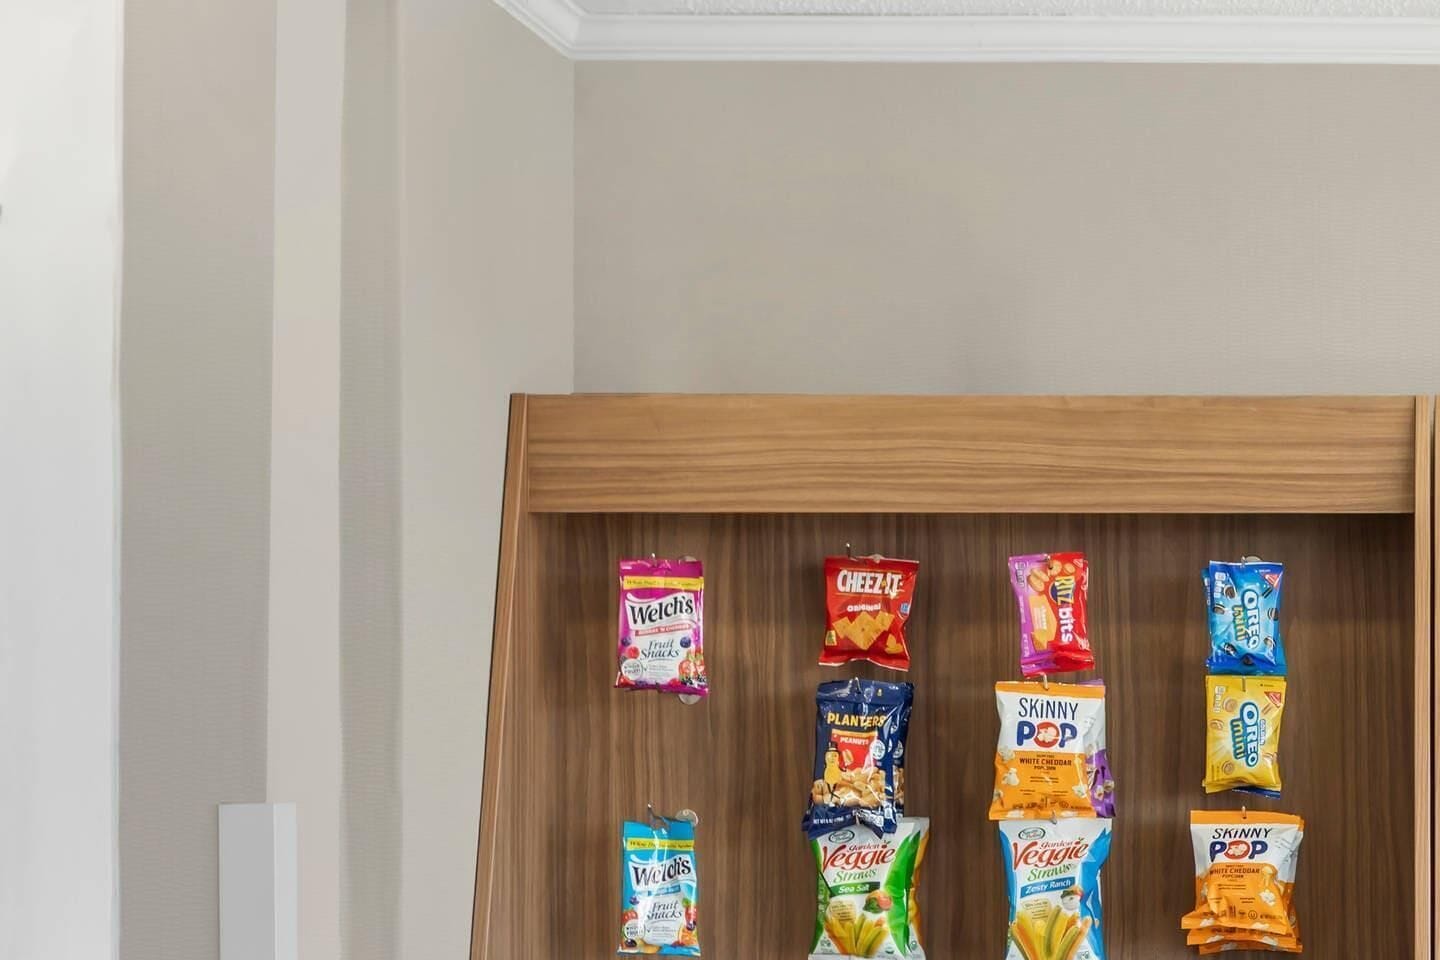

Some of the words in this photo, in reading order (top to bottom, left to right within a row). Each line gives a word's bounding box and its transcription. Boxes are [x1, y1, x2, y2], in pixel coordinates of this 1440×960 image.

[629, 595, 694, 625] Welch's
[1243, 589, 1260, 649] OREO
[641, 648, 680, 659] Snacks
[648, 639, 674, 651] Fruit
[827, 711, 888, 728] PLANTERS
[1016, 720, 1078, 748] POP
[1231, 719, 1245, 759] mini
[1242, 703, 1258, 767] OREO
[1019, 757, 1040, 765] WHITE
[1041, 758, 1073, 766] CHEDDAR
[822, 844, 896, 873] Veggie
[1012, 841, 1089, 870] Veggie
[1209, 840, 1269, 862] POP
[632, 857, 692, 886] Welch's
[833, 868, 877, 884] Straws
[1027, 863, 1072, 882] Straws
[838, 886, 855, 894] Sea
[856, 884, 870, 893] Salt
[1025, 884, 1049, 894] Zesty
[1050, 880, 1072, 890] Ranch
[646, 909, 682, 921] Snacks
[651, 900, 679, 912] Fruit
